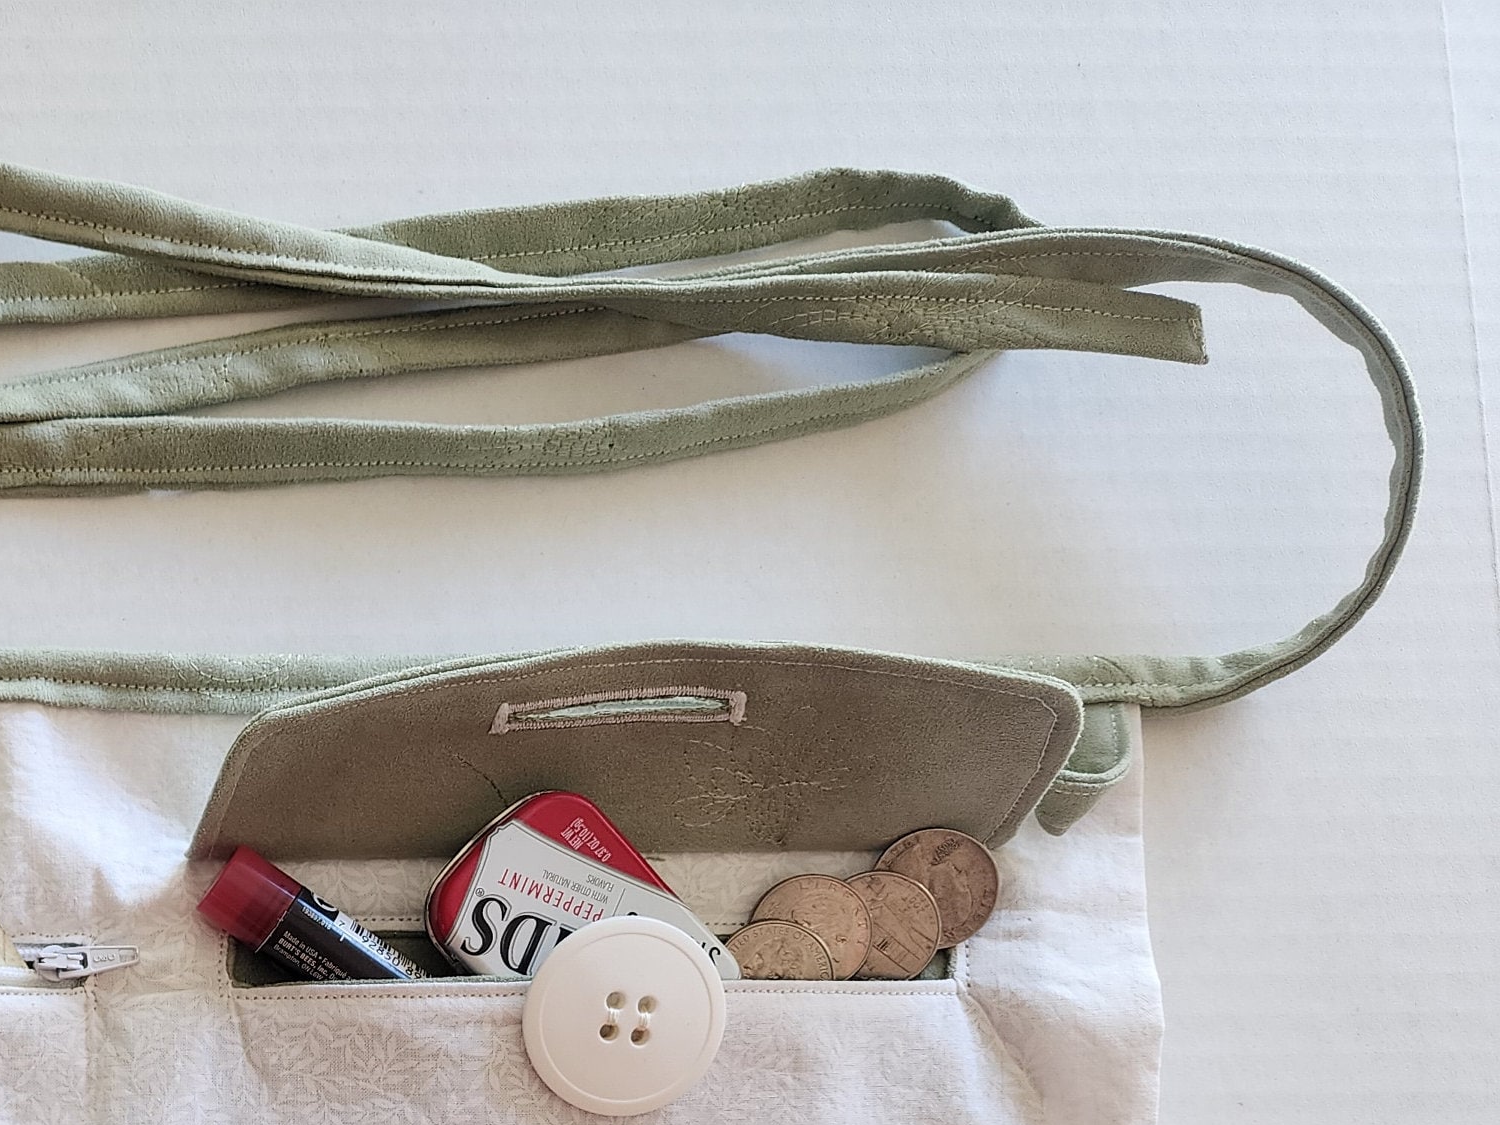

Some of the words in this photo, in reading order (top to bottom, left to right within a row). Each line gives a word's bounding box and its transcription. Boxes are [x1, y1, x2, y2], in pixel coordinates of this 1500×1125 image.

[560, 826, 573, 840] WT
[570, 817, 594, 841] (10.5g)
[568, 835, 584, 850] NET
[595, 846, 612, 862] 0.37
[542, 869, 570, 888] NATURAL
[587, 874, 614, 892] FLAVORS
[498, 868, 604, 922] PEPPERMINT
[571, 881, 590, 896] OTHER
[590, 892, 609, 904] WITH
[278, 938, 300, 956] BURT'S
[283, 930, 300, 945] Made
[305, 946, 318, 958] USA
[361, 936, 401, 966] 92850
[805, 941, 830, 980] AMERIC
